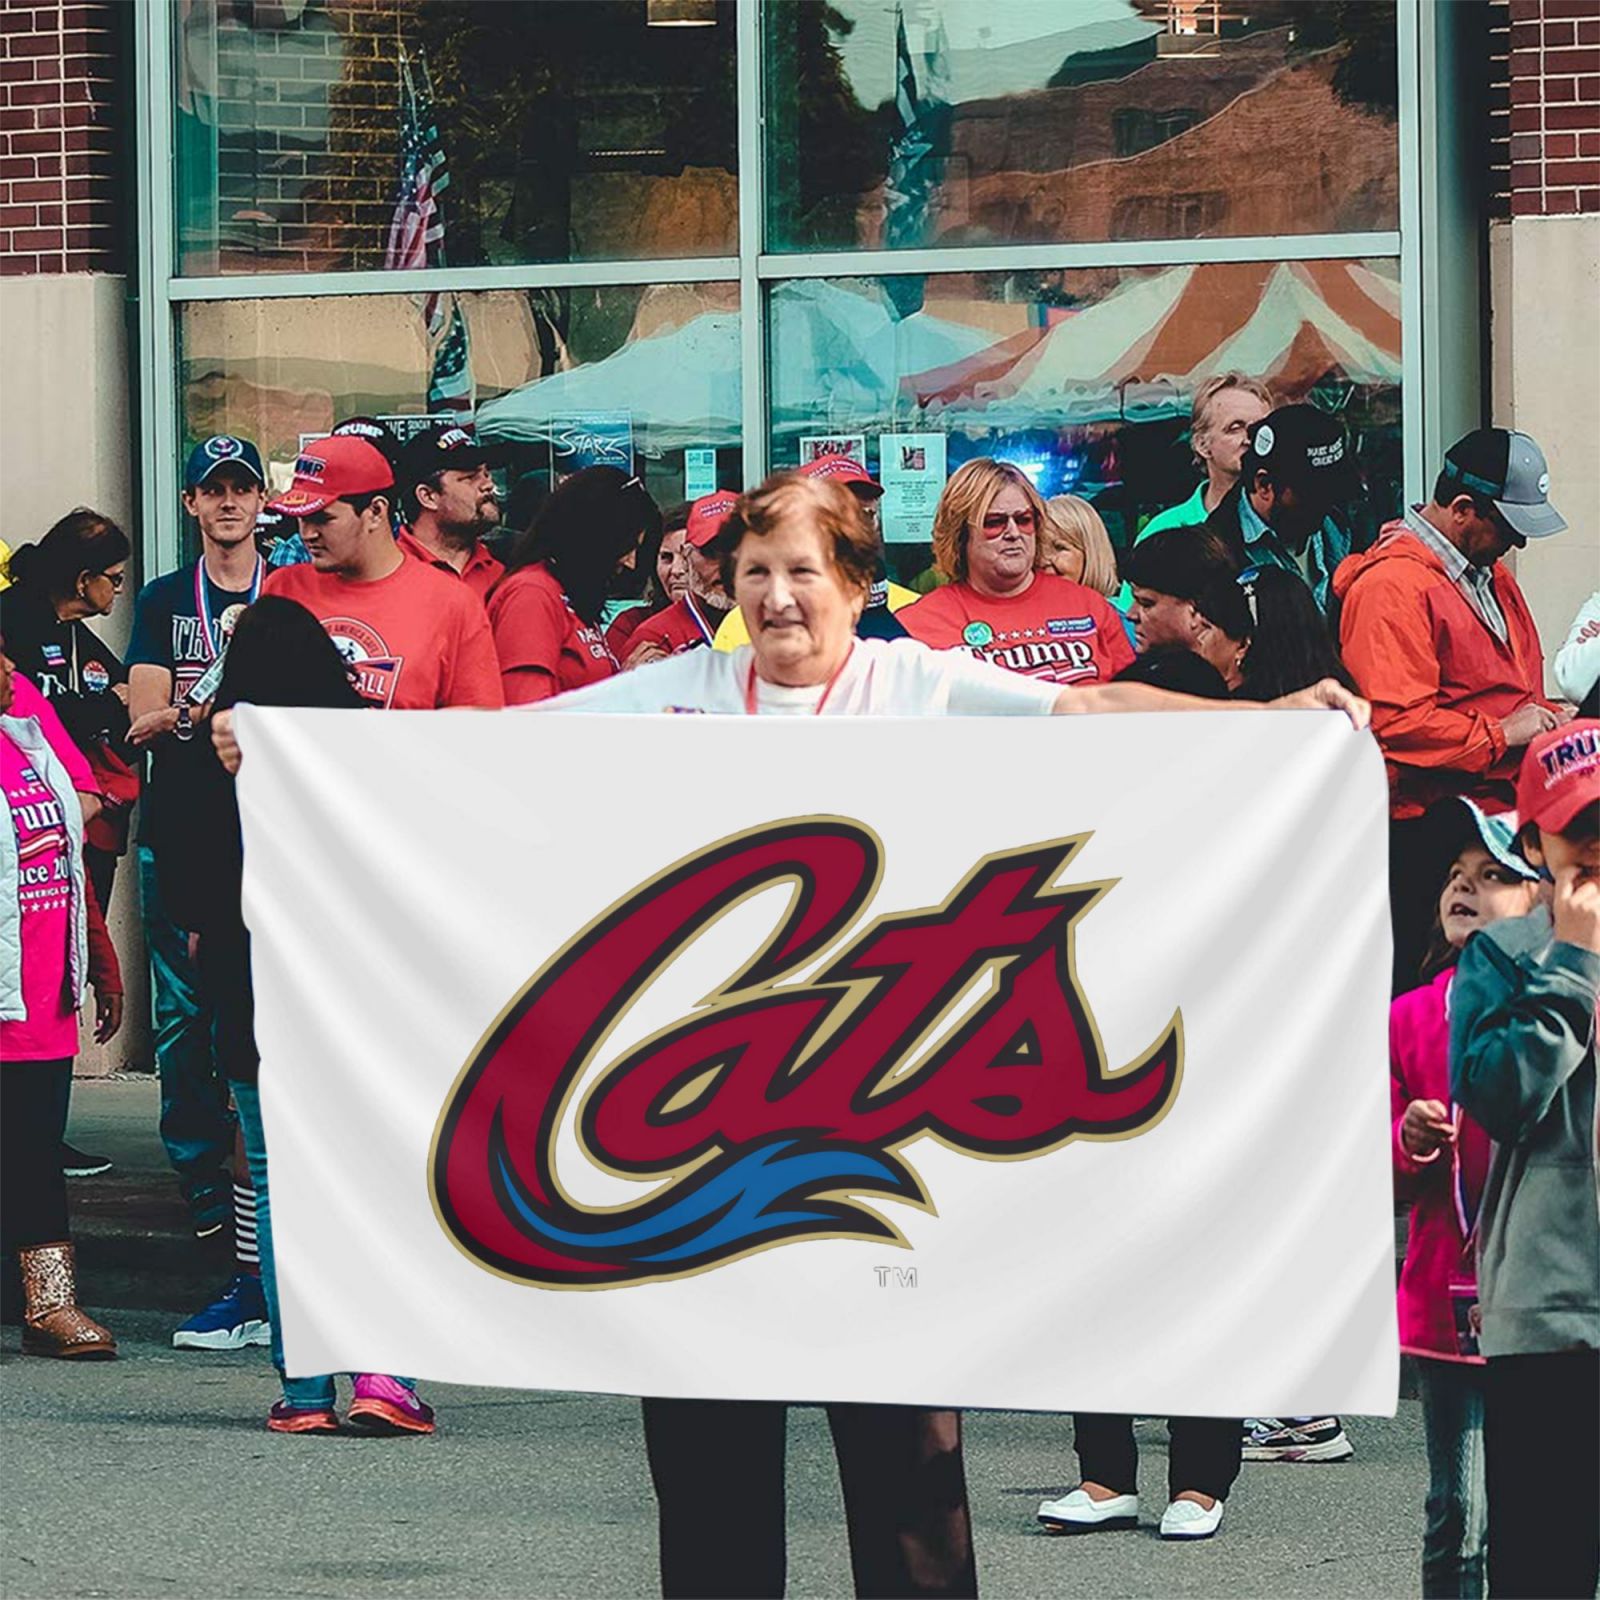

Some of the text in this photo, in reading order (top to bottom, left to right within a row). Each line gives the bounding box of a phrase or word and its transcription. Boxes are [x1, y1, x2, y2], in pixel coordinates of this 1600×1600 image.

[333, 423, 384, 437] TRUMP
[555, 430, 629, 460] STARZ
[427, 813, 1185, 1292] Cats
[873, 1266, 918, 1288] TM
